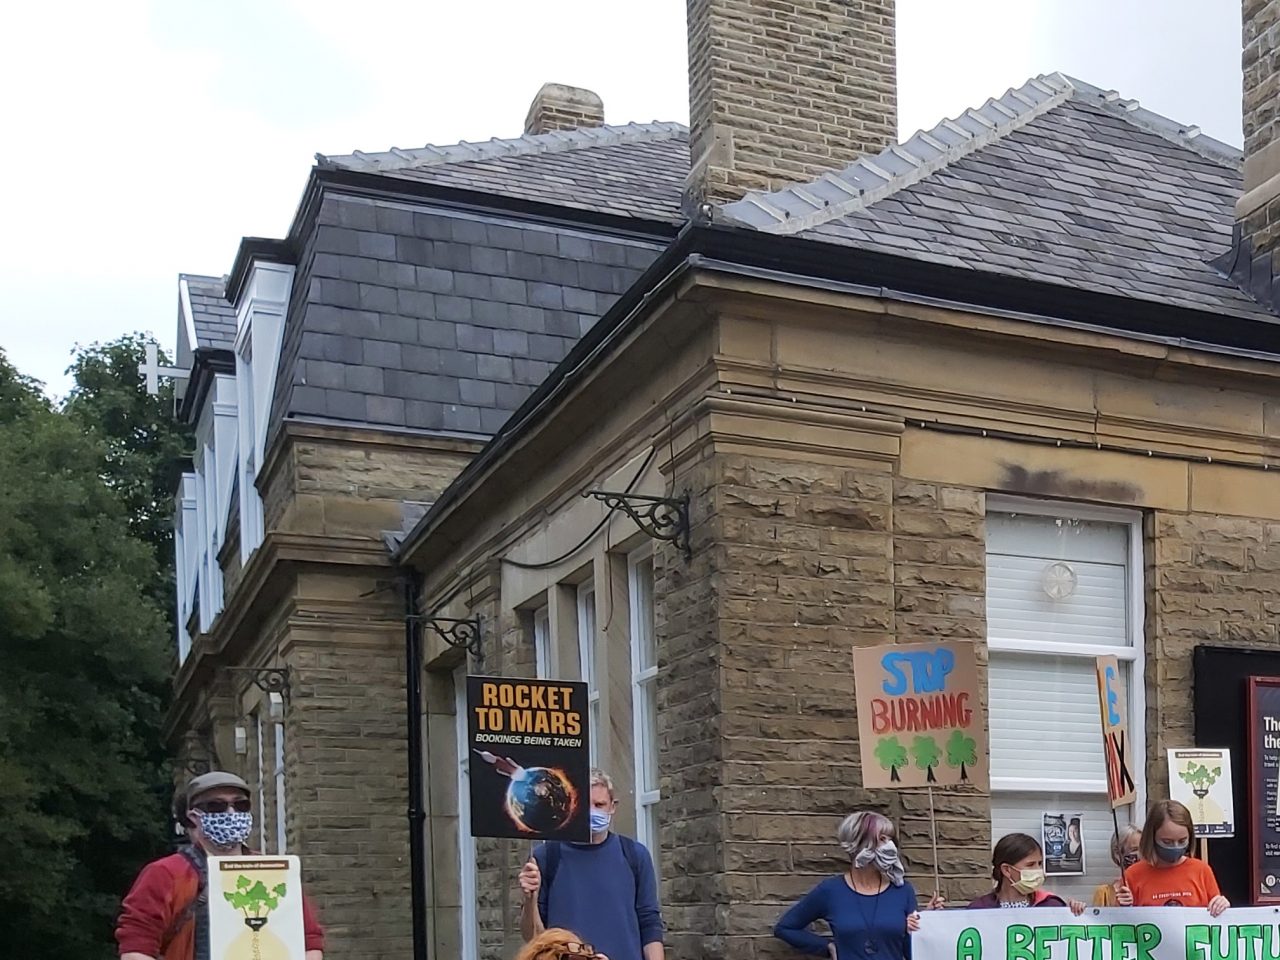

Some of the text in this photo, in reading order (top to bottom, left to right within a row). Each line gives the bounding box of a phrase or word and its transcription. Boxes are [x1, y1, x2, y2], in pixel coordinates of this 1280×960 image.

[881, 647, 956, 696] STOP
[482, 682, 574, 711] ROCKET
[475, 707, 581, 736] TO MARS
[871, 691, 973, 735] BURNING
[475, 733, 582, 748] BOOKINGS BEING TAKEN
